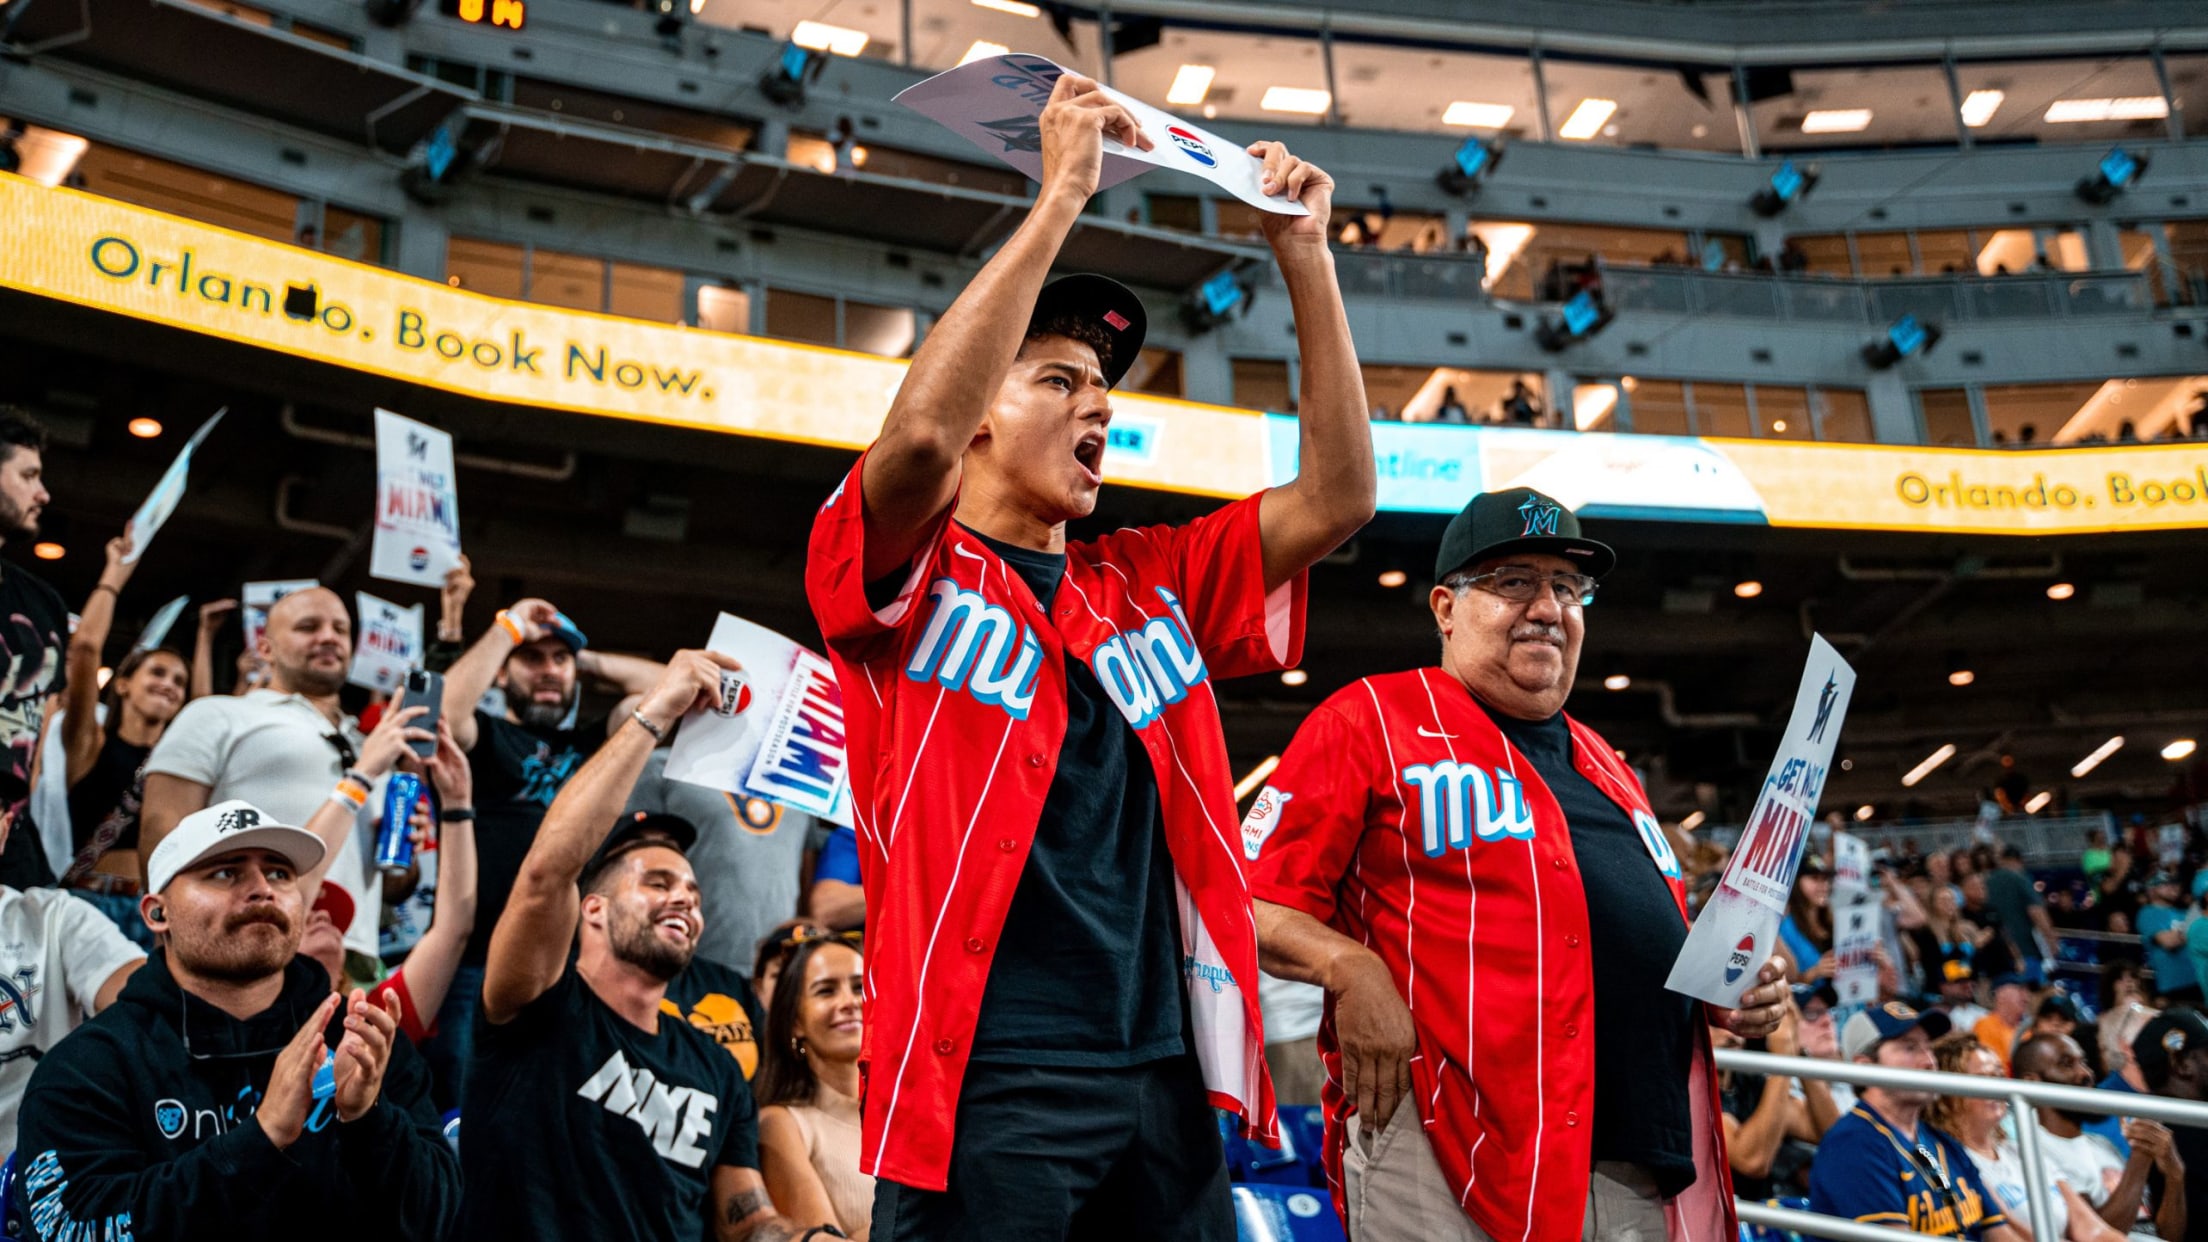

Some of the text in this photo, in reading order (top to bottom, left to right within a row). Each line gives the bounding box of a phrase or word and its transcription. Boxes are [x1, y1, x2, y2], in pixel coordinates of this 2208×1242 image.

[1171, 134, 1213, 157] PEPSI
[91, 236, 712, 398] Orlano. Book Now.
[1900, 471, 2093, 506] Orlando.
[721, 679, 741, 716] PEPSI
[762, 669, 846, 800] MIAMI
[1777, 757, 1807, 798] GET
